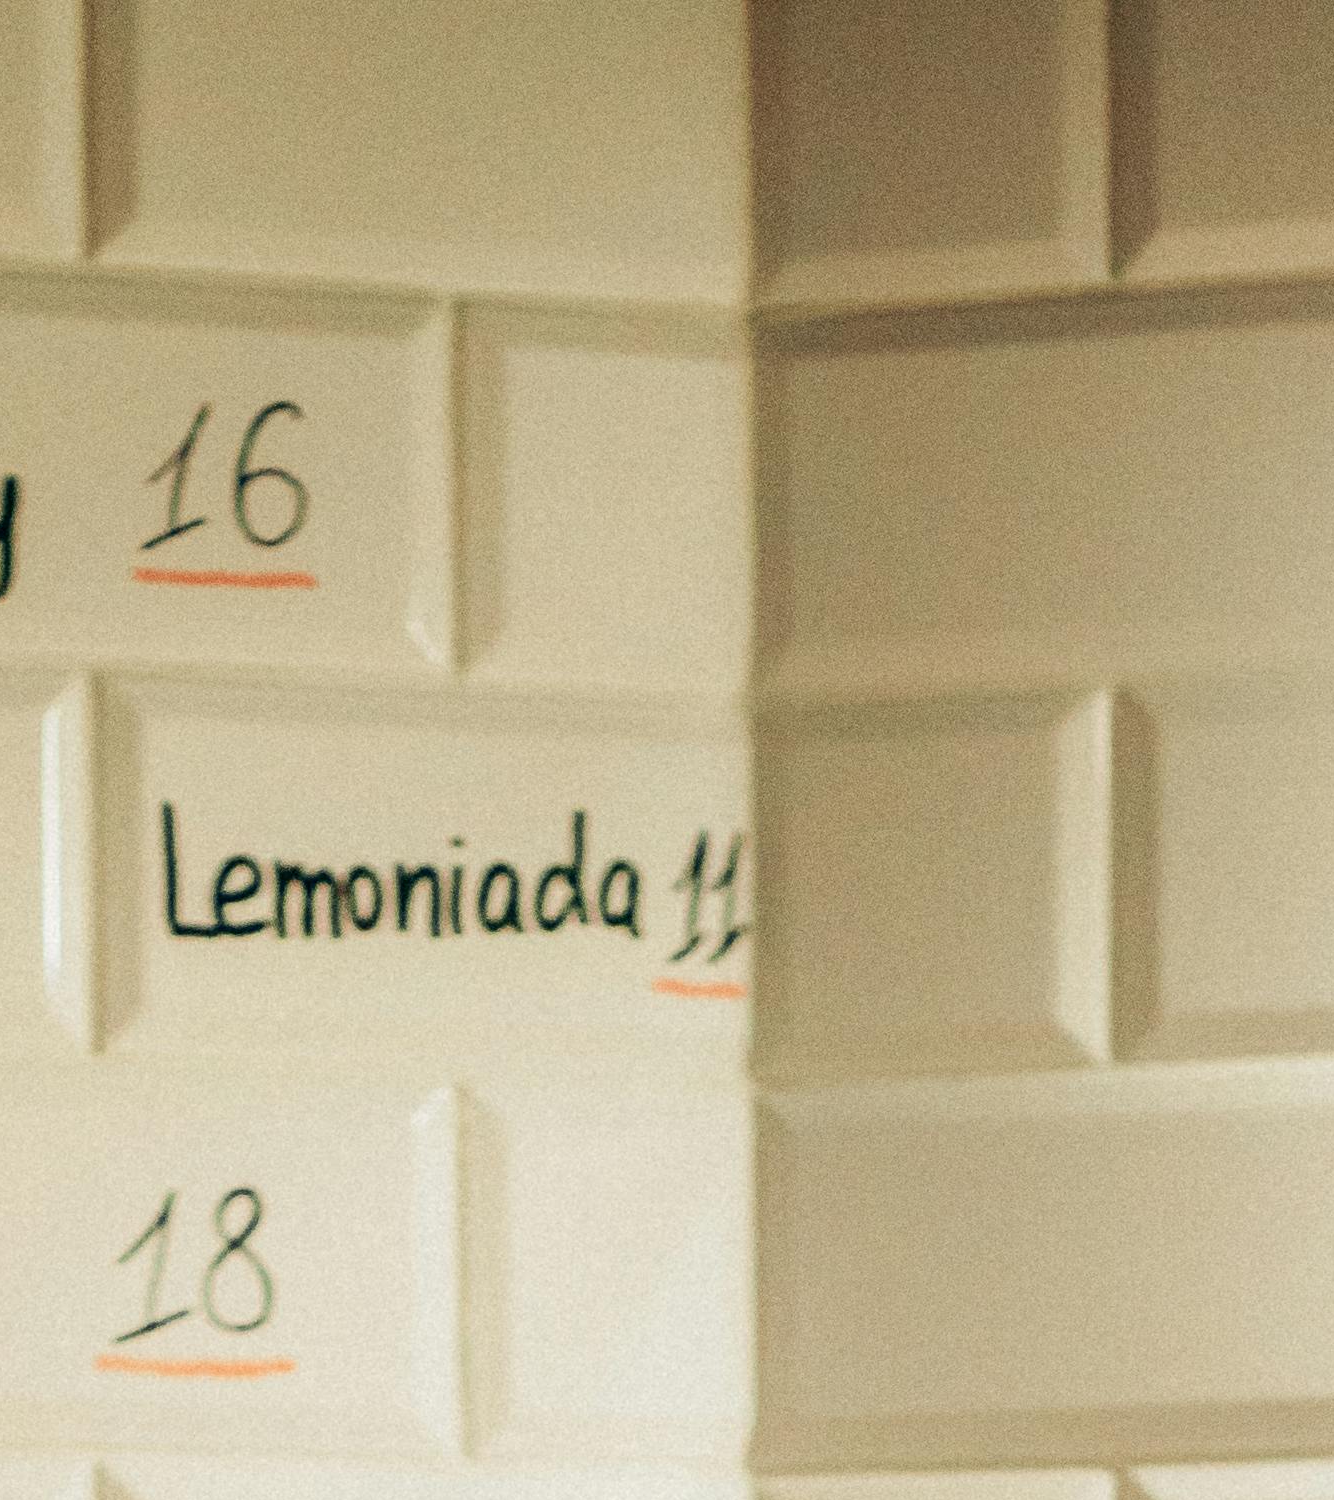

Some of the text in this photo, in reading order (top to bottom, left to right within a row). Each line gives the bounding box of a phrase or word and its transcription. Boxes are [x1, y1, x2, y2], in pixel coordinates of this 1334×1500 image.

[140, 399, 309, 552] 16
[159, 800, 753, 964] Lemoniada 11
[112, 1185, 274, 1344] 18
